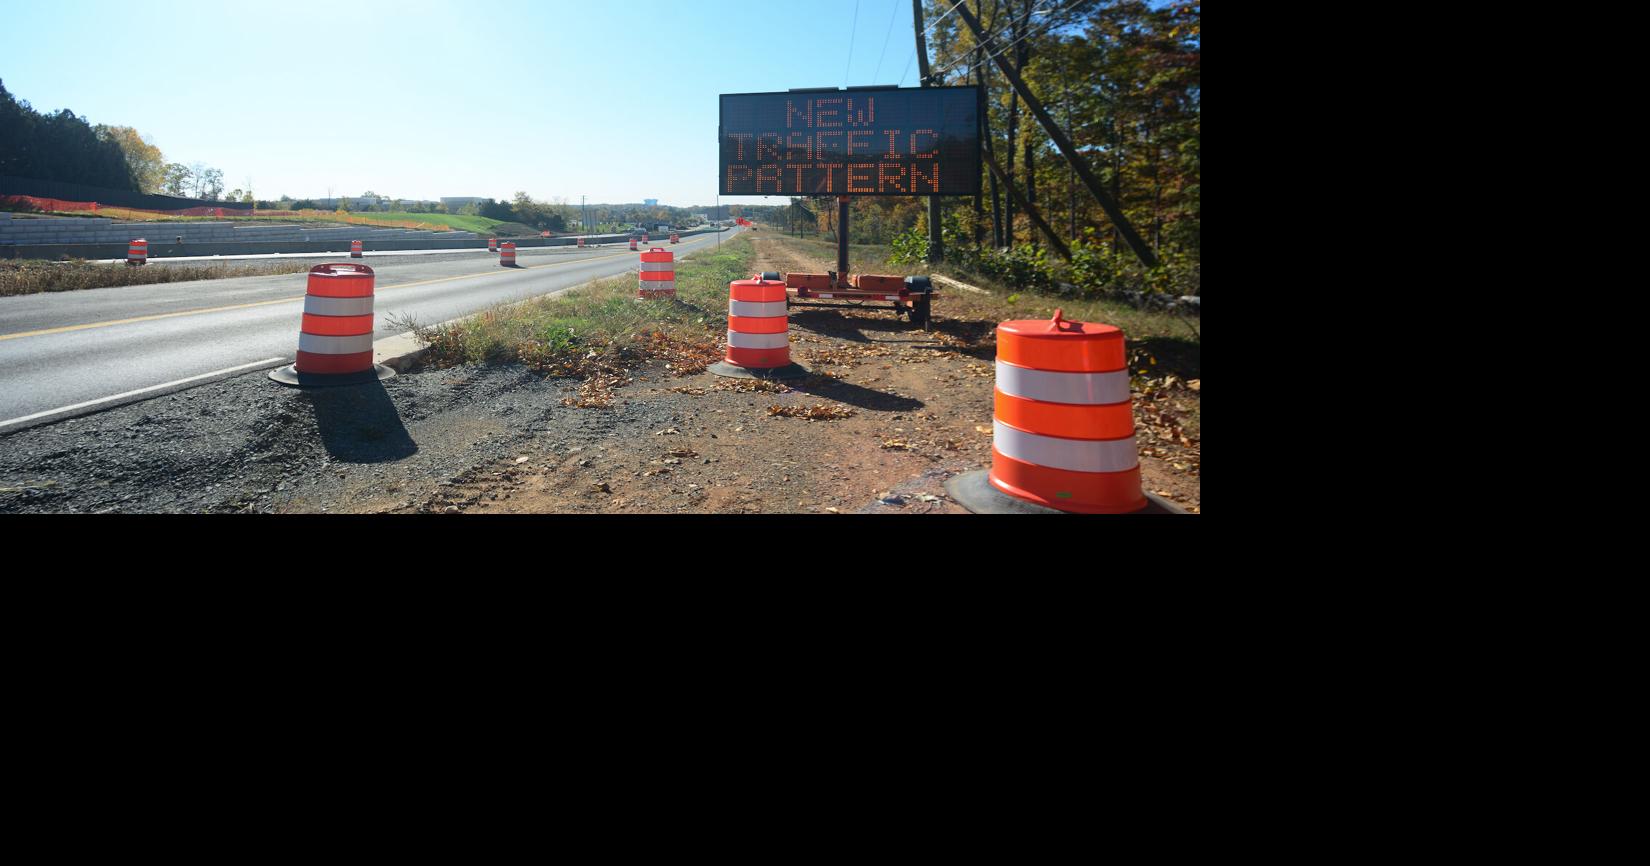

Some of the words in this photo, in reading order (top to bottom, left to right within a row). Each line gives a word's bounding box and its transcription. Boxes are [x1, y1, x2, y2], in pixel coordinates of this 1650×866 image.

[786, 97, 875, 128] NEW
[728, 129, 939, 160] TRAFFIC
[728, 163, 939, 193] PATTERN
